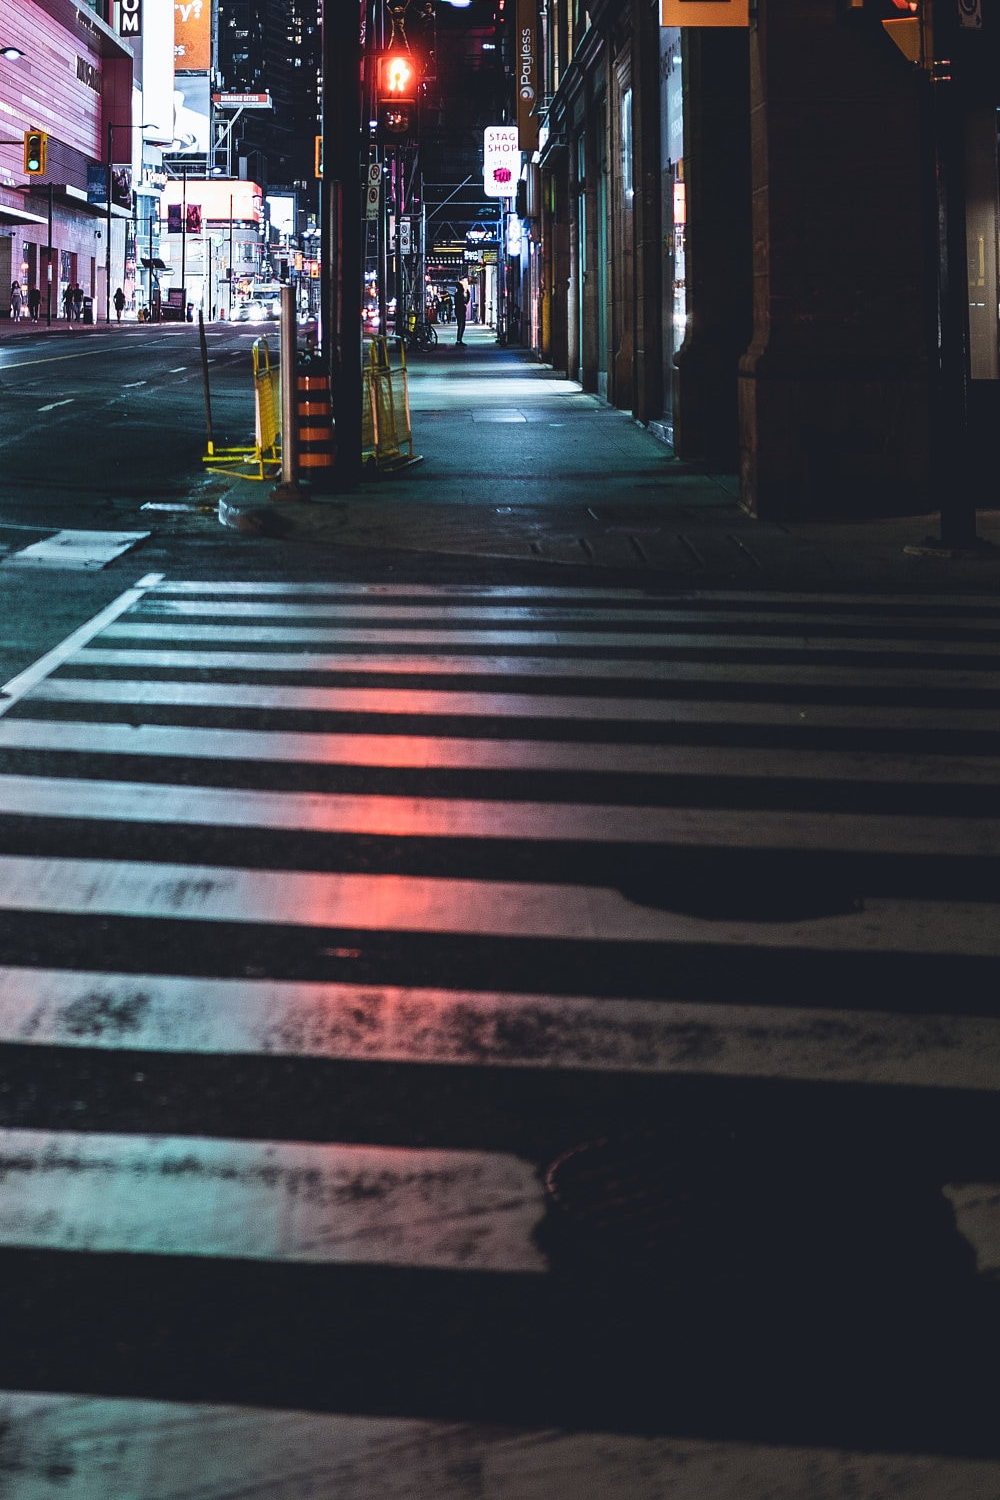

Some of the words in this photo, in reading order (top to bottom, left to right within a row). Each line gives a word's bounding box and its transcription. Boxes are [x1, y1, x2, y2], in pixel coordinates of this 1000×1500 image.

[520, 28, 534, 85] Payless
[489, 132, 516, 142] STAG
[488, 144, 517, 153] SHOP
